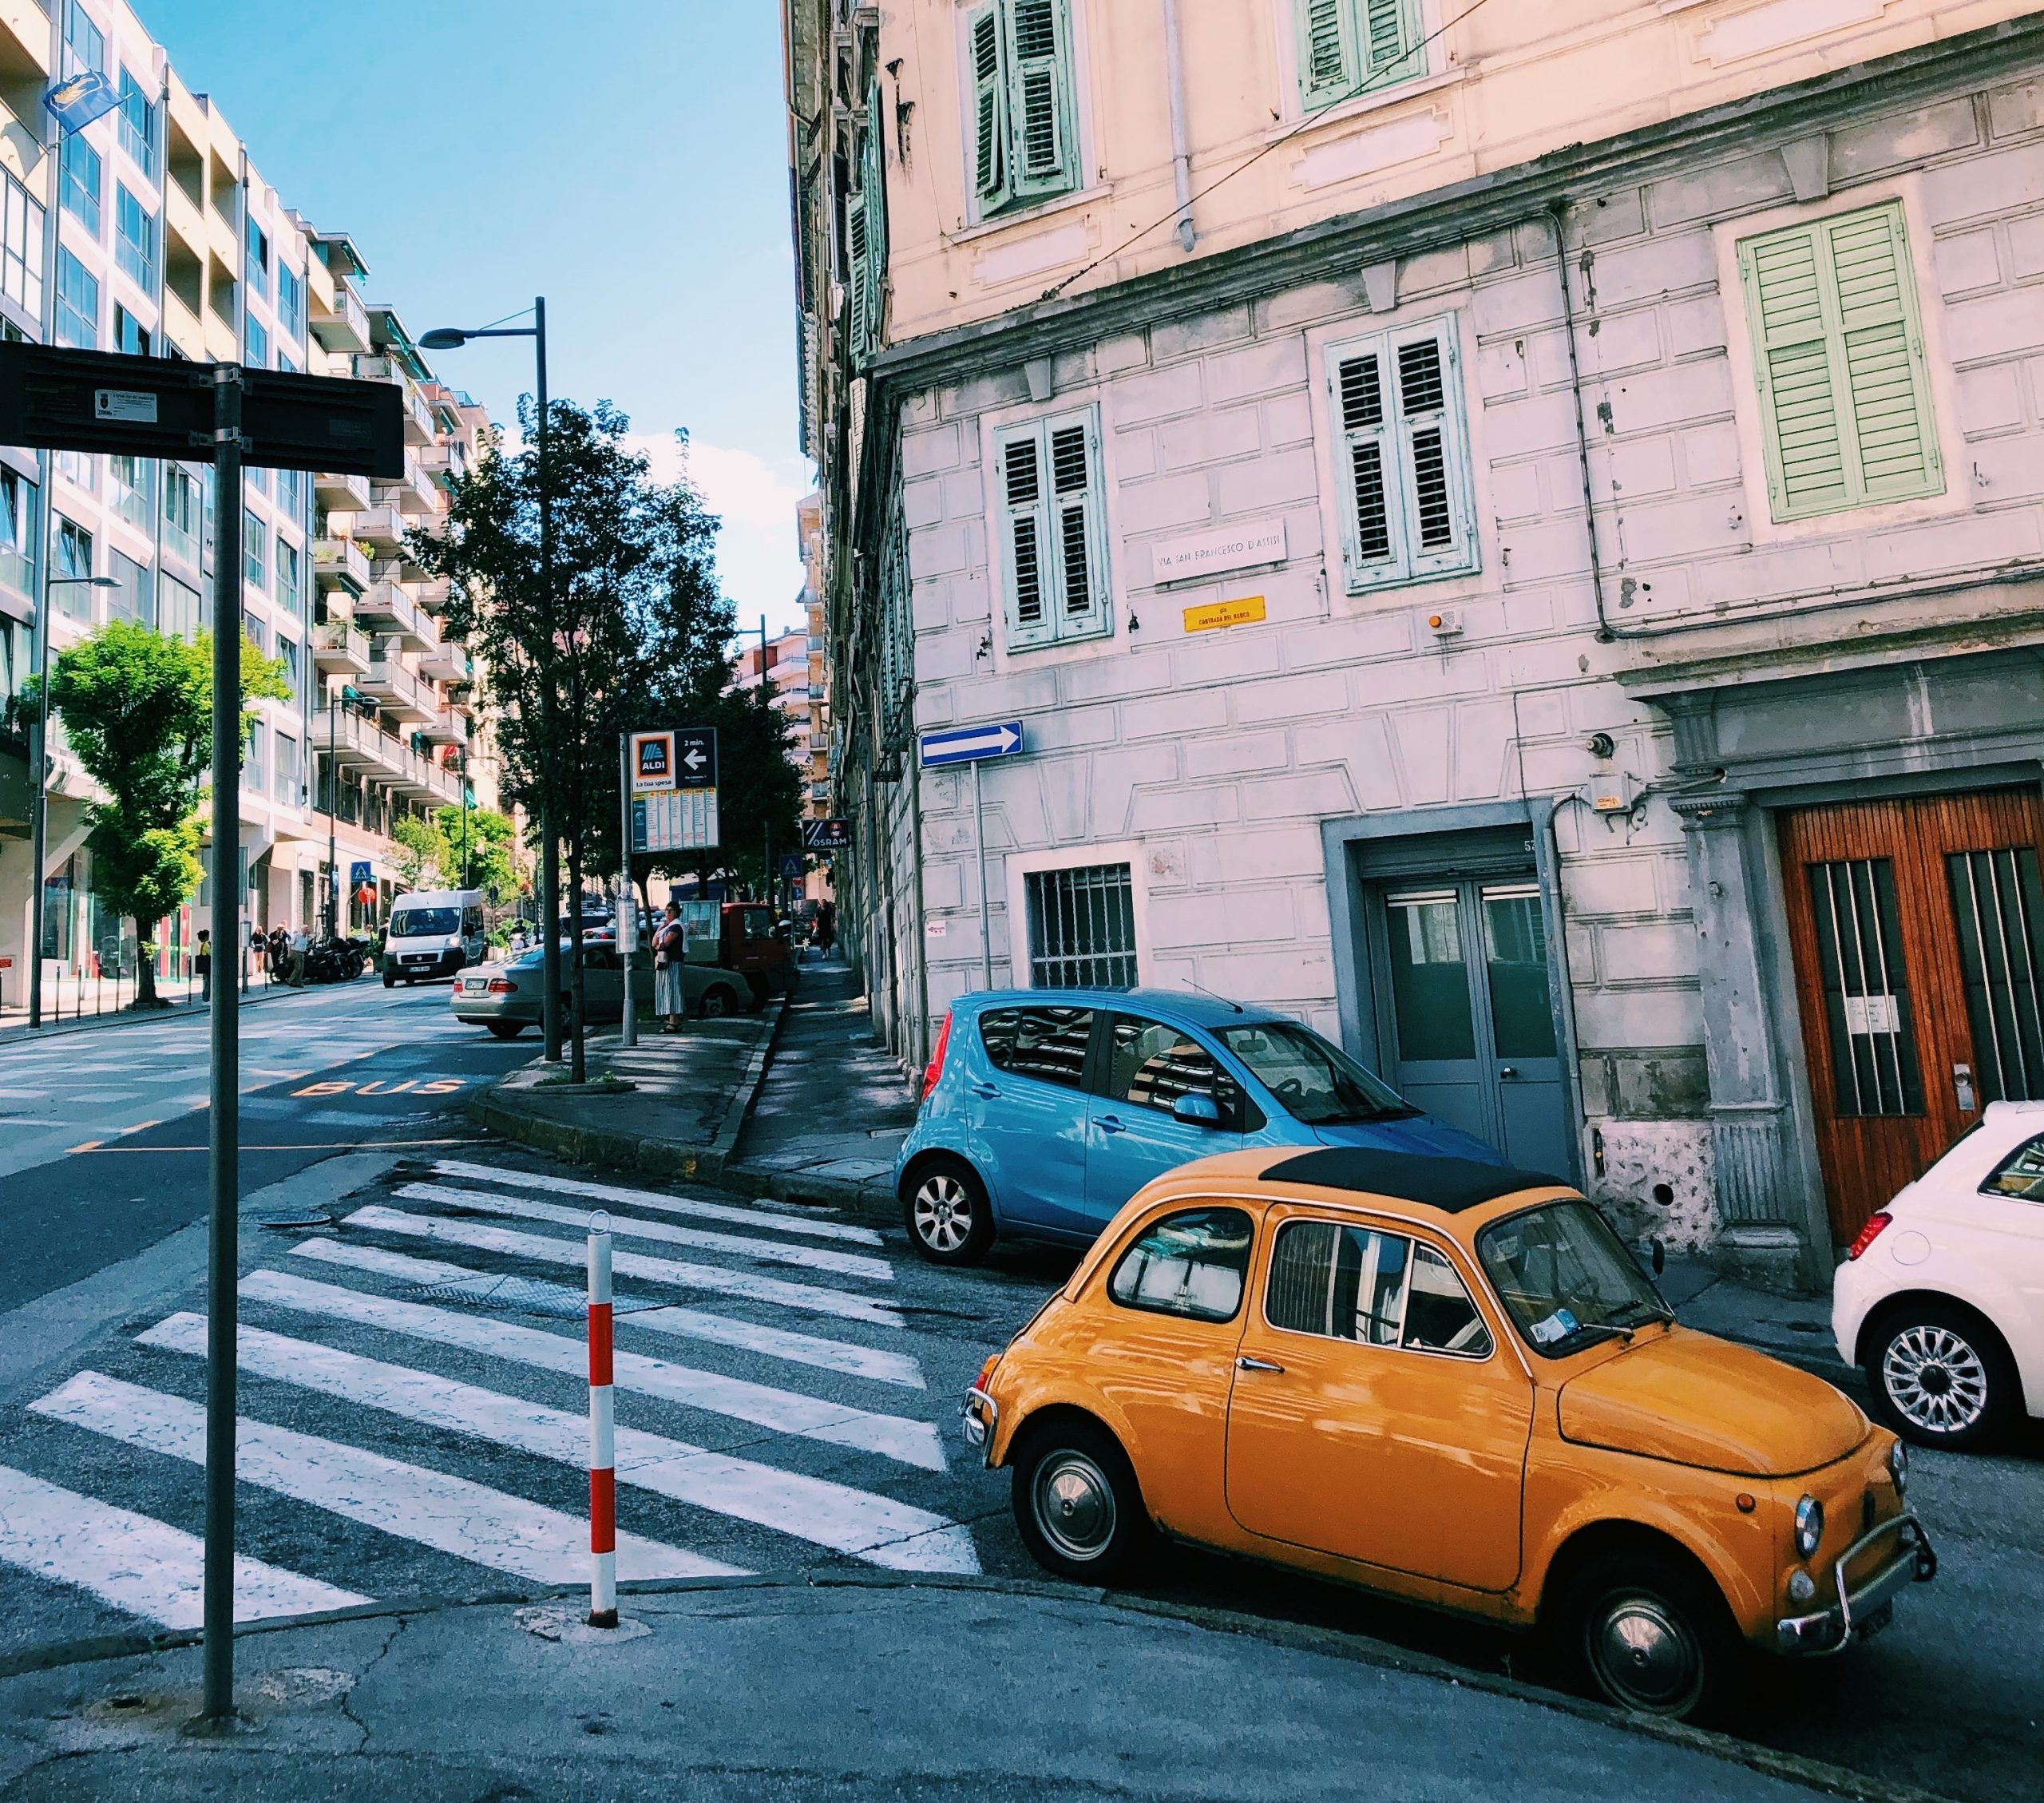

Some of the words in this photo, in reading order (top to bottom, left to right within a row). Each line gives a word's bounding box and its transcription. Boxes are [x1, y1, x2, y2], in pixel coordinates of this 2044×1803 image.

[1158, 557, 1171, 566] VIA
[1175, 552, 1190, 564] SAN
[1195, 542, 1243, 561] FRANCESCO
[1248, 535, 1280, 550] D'ASSISI
[642, 761, 665, 771] ALDI
[813, 838, 846, 846] OSRAM
[289, 1080, 467, 1097] BUS
